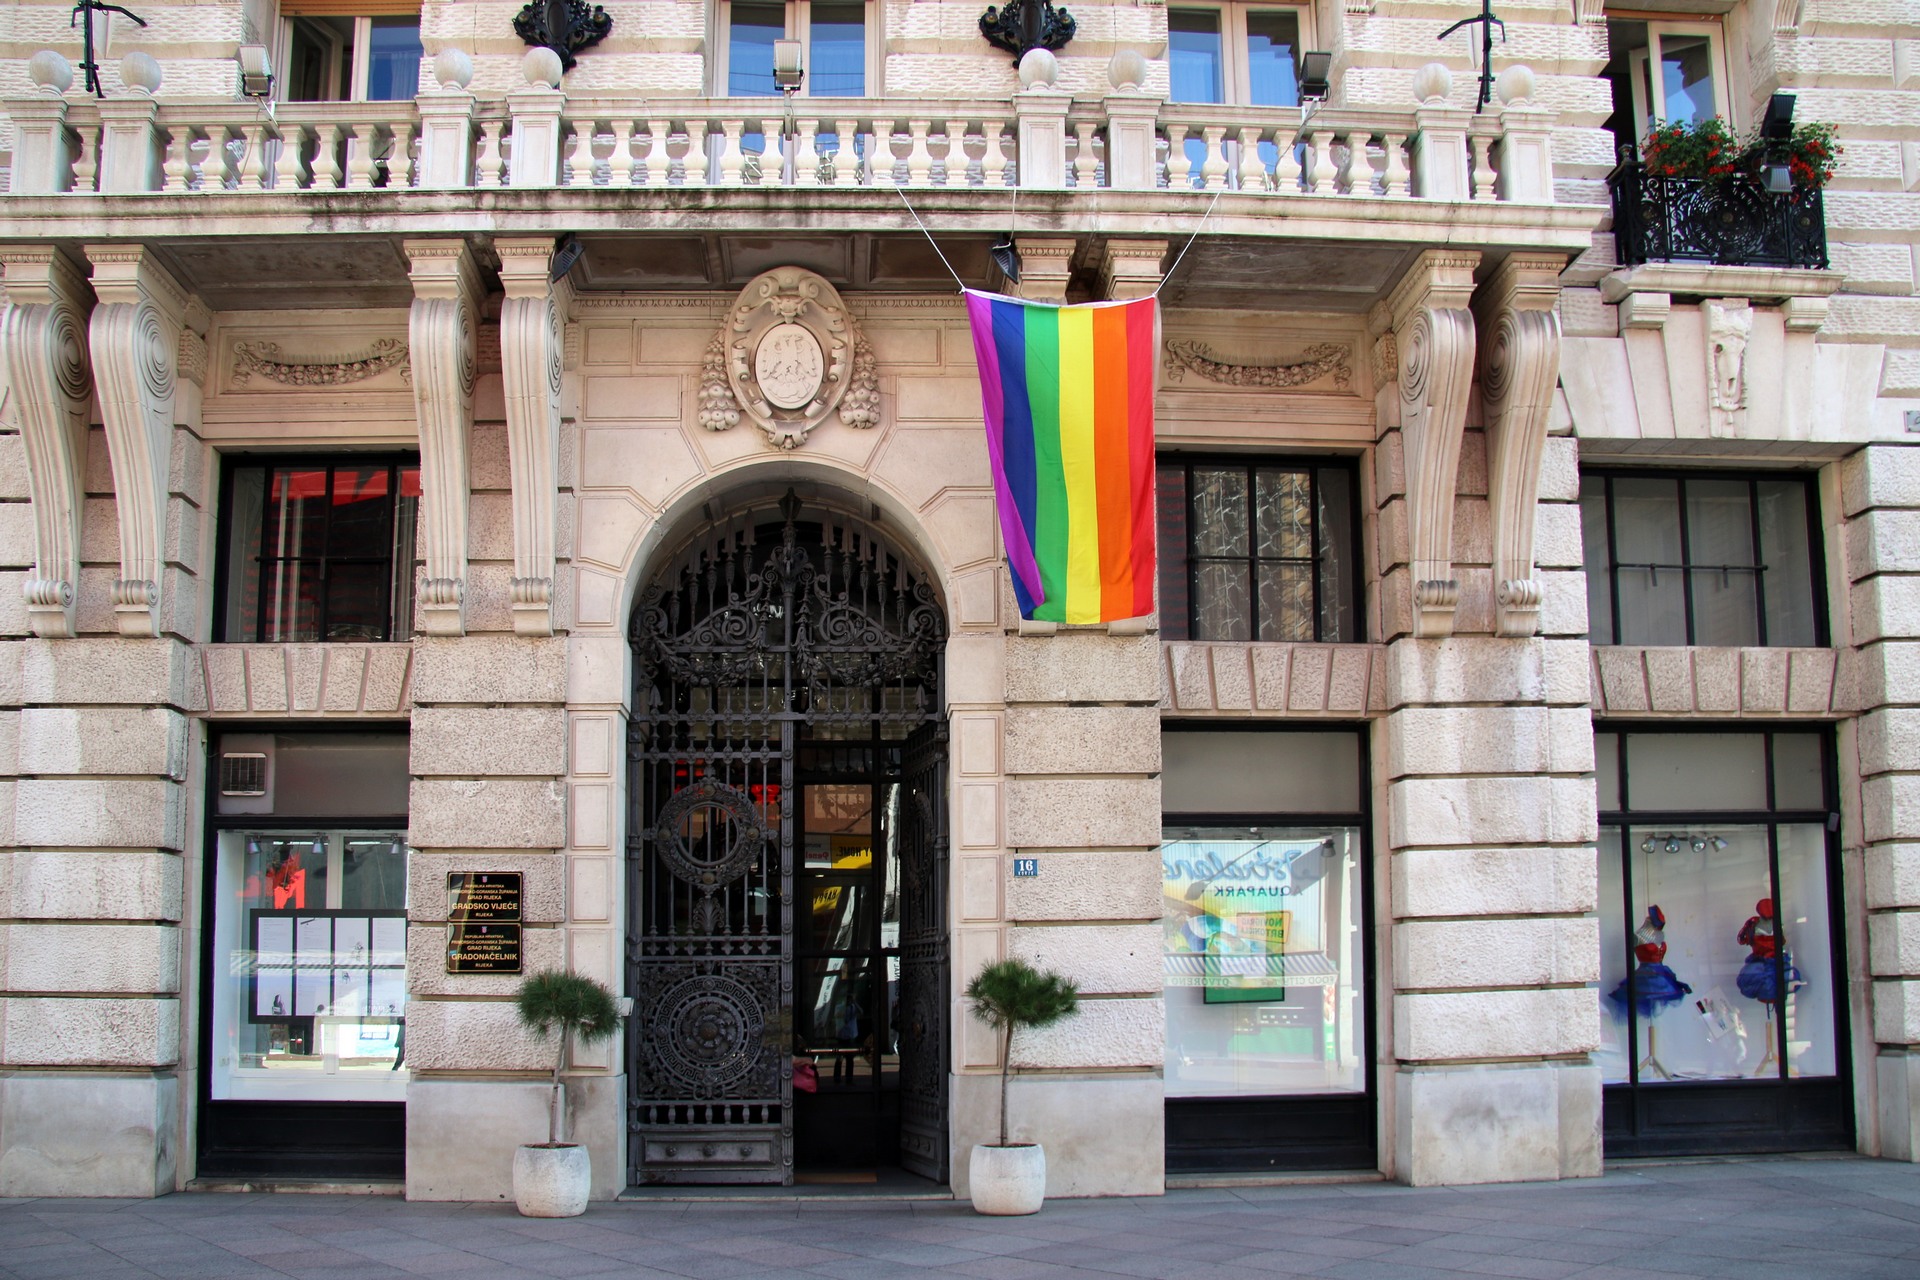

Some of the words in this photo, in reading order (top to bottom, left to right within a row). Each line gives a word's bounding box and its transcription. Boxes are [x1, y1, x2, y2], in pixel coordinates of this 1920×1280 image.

[1019, 860, 1034, 871] 16
[451, 902, 490, 910] GRADSKO
[490, 901, 518, 910] VIJEĆE
[451, 952, 518, 960] GRADONAČELNIK
